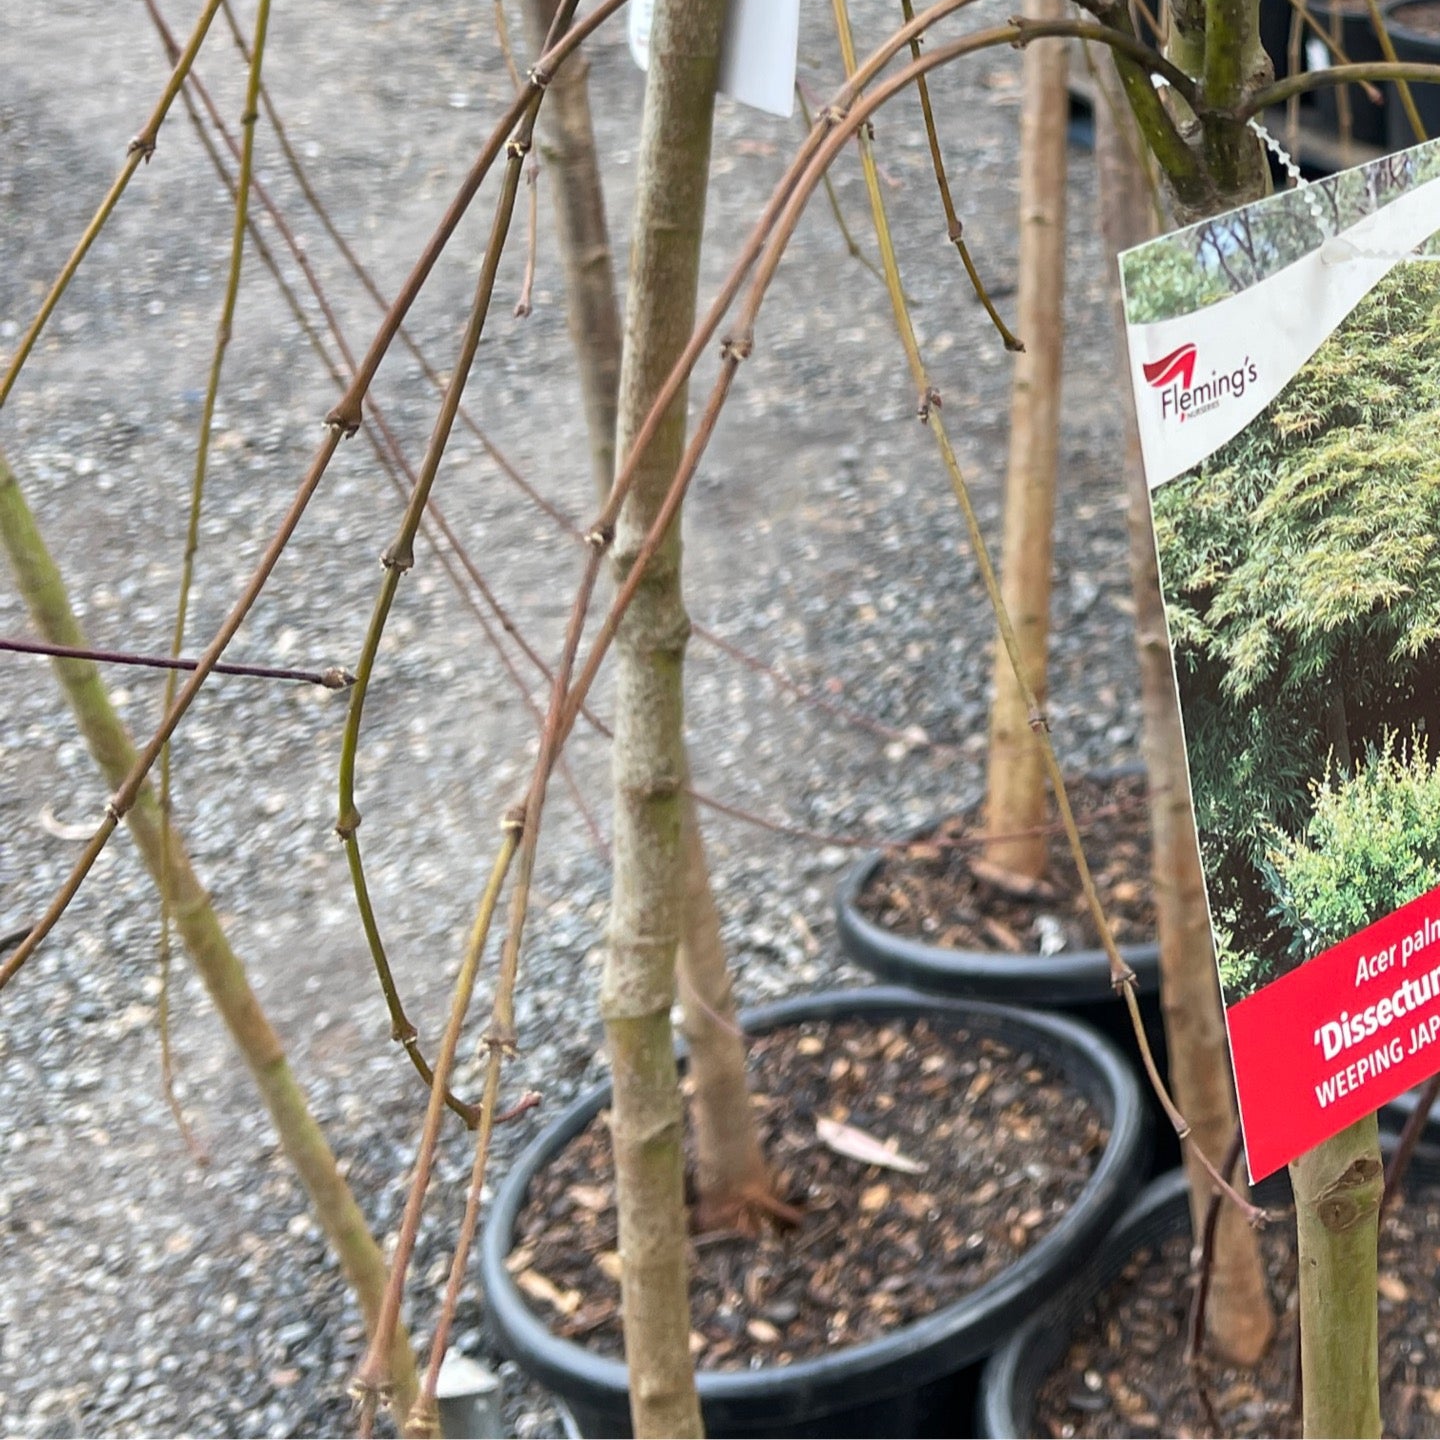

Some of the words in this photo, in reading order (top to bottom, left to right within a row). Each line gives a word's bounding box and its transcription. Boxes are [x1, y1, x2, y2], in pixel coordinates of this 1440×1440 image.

[1161, 355, 1258, 420] Fleming's
[1355, 943, 1397, 987] Acer
[1314, 1037, 1404, 1109] WEEPING
